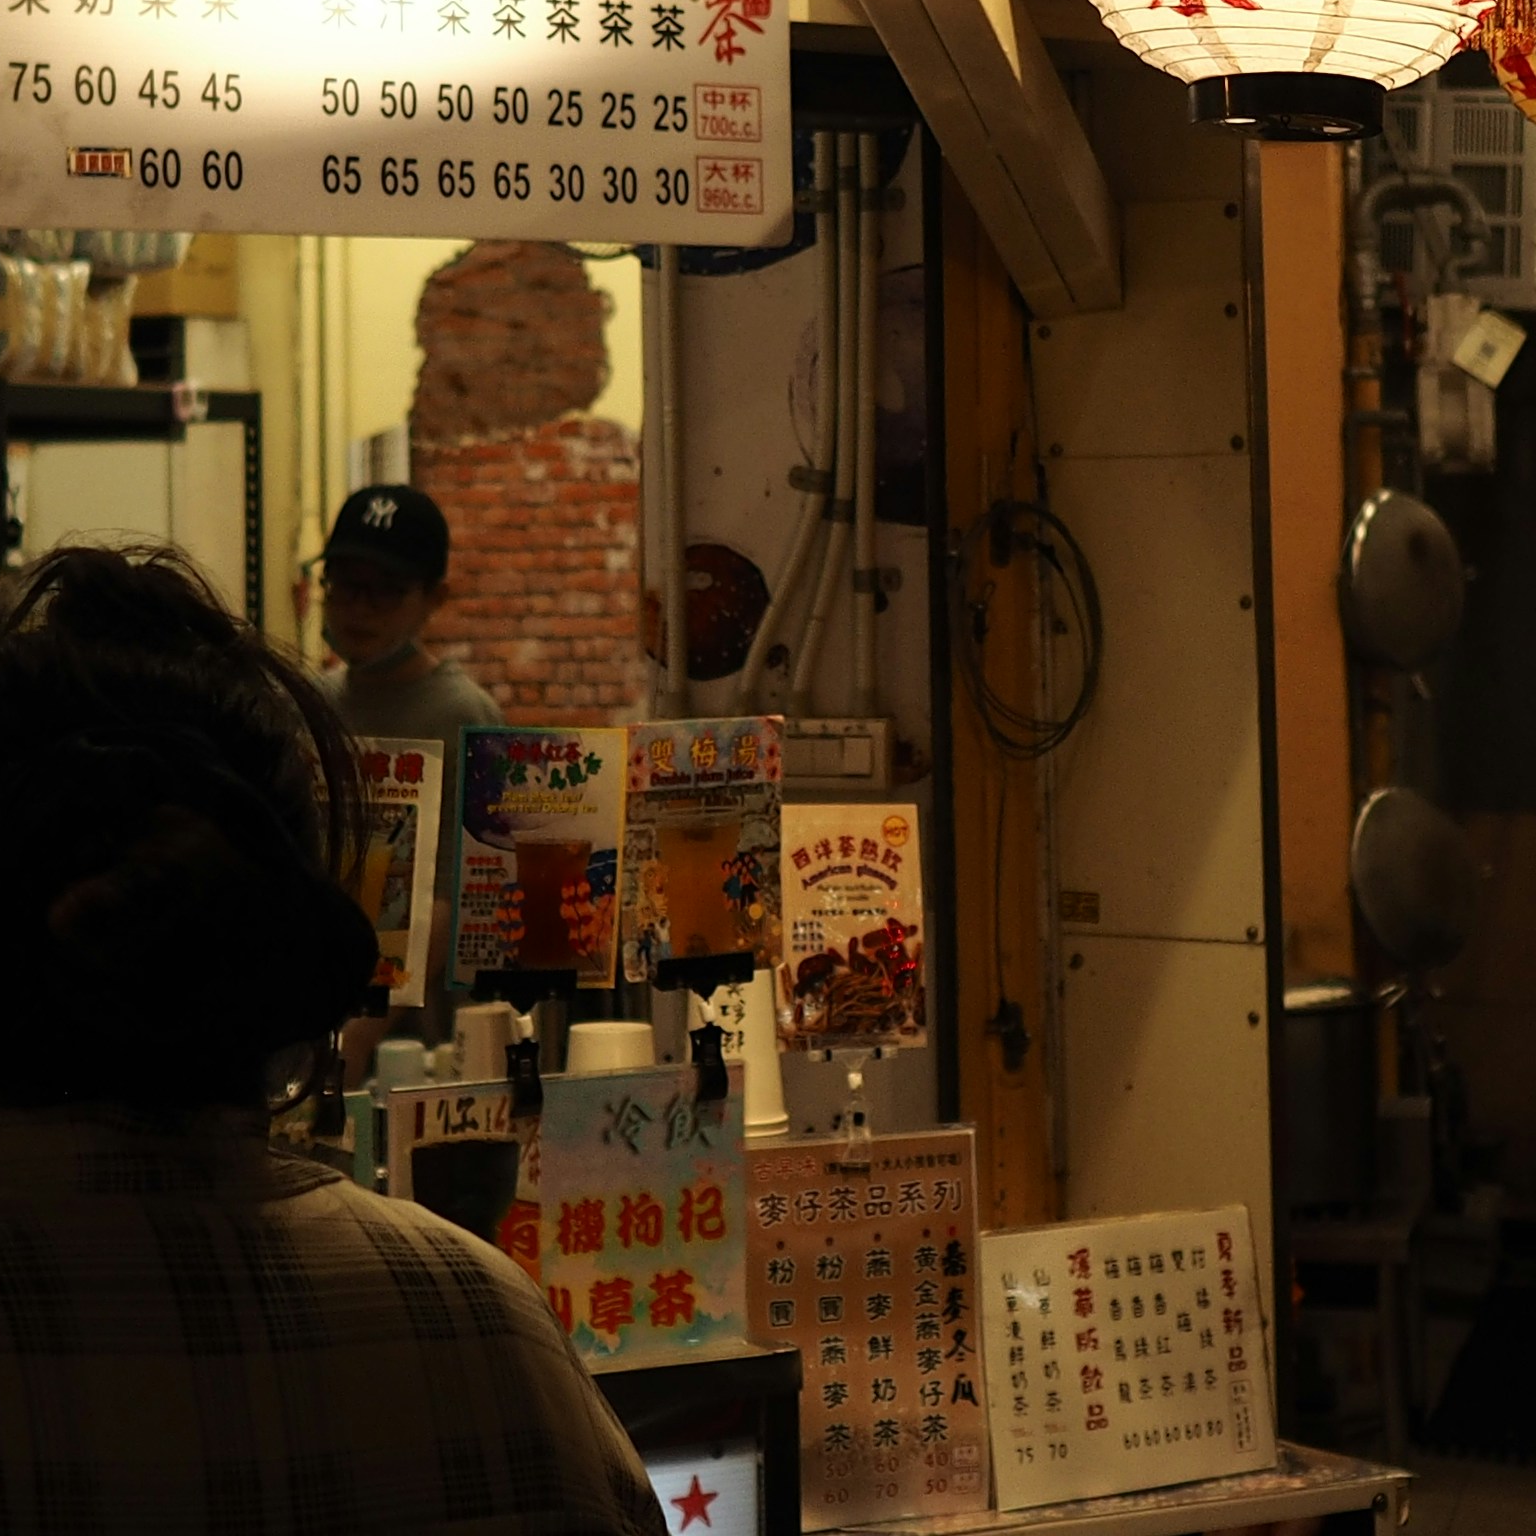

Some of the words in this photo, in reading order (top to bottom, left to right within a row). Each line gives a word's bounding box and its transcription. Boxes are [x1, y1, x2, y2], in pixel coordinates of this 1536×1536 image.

[8, 61, 53, 104] 75
[74, 65, 117, 107] 60
[138, 68, 182, 110] 45
[201, 72, 243, 114] 45
[321, 77, 361, 118] 50
[379, 80, 418, 120] 50
[436, 83, 474, 123] 50
[492, 86, 530, 126] 50
[547, 89, 584, 128] 25
[601, 92, 637, 131] 25
[653, 94, 688, 133] 25
[702, 91, 752, 112] 中杯
[139, 147, 183, 189] 60
[202, 149, 244, 191] 60
[321, 154, 362, 194] 65
[379, 157, 420, 197] 65
[436, 160, 477, 200] 65
[492, 161, 532, 201] 65
[548, 164, 586, 203] 30
[602, 165, 638, 205] 30
[654, 167, 690, 207] 30
[704, 163, 754, 184] 大杯
[650, 735, 760, 773] 雙梅湯
[758, 1179, 964, 1229] 麥仔茶品系列
